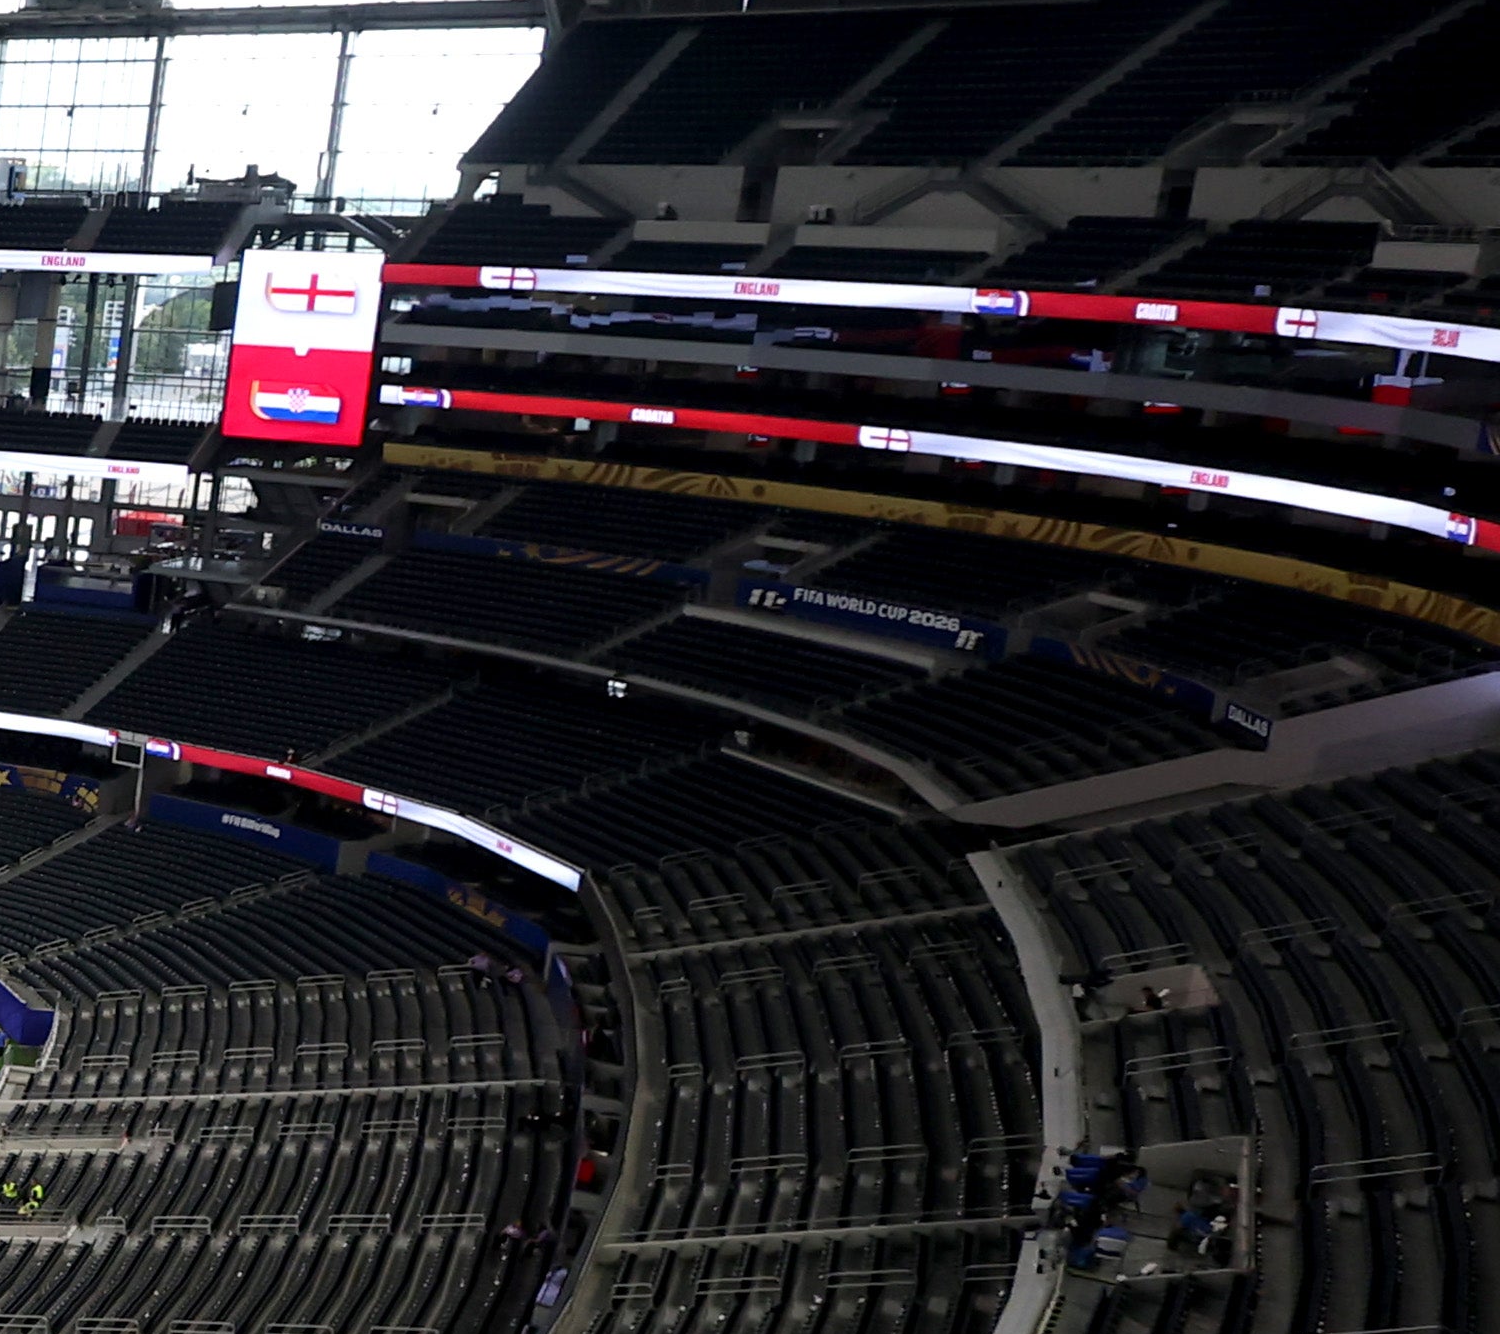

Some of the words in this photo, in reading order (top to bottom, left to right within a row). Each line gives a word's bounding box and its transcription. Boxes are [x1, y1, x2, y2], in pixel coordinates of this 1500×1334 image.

[41, 255, 86, 267] ENGLAND
[734, 281, 780, 296] ENGLAND
[321, 522, 382, 538] DALLAS
[794, 587, 824, 606] FIFA
[826, 594, 876, 615] WORLD
[878, 603, 908, 620] CUP
[908, 609, 960, 632] 2026
